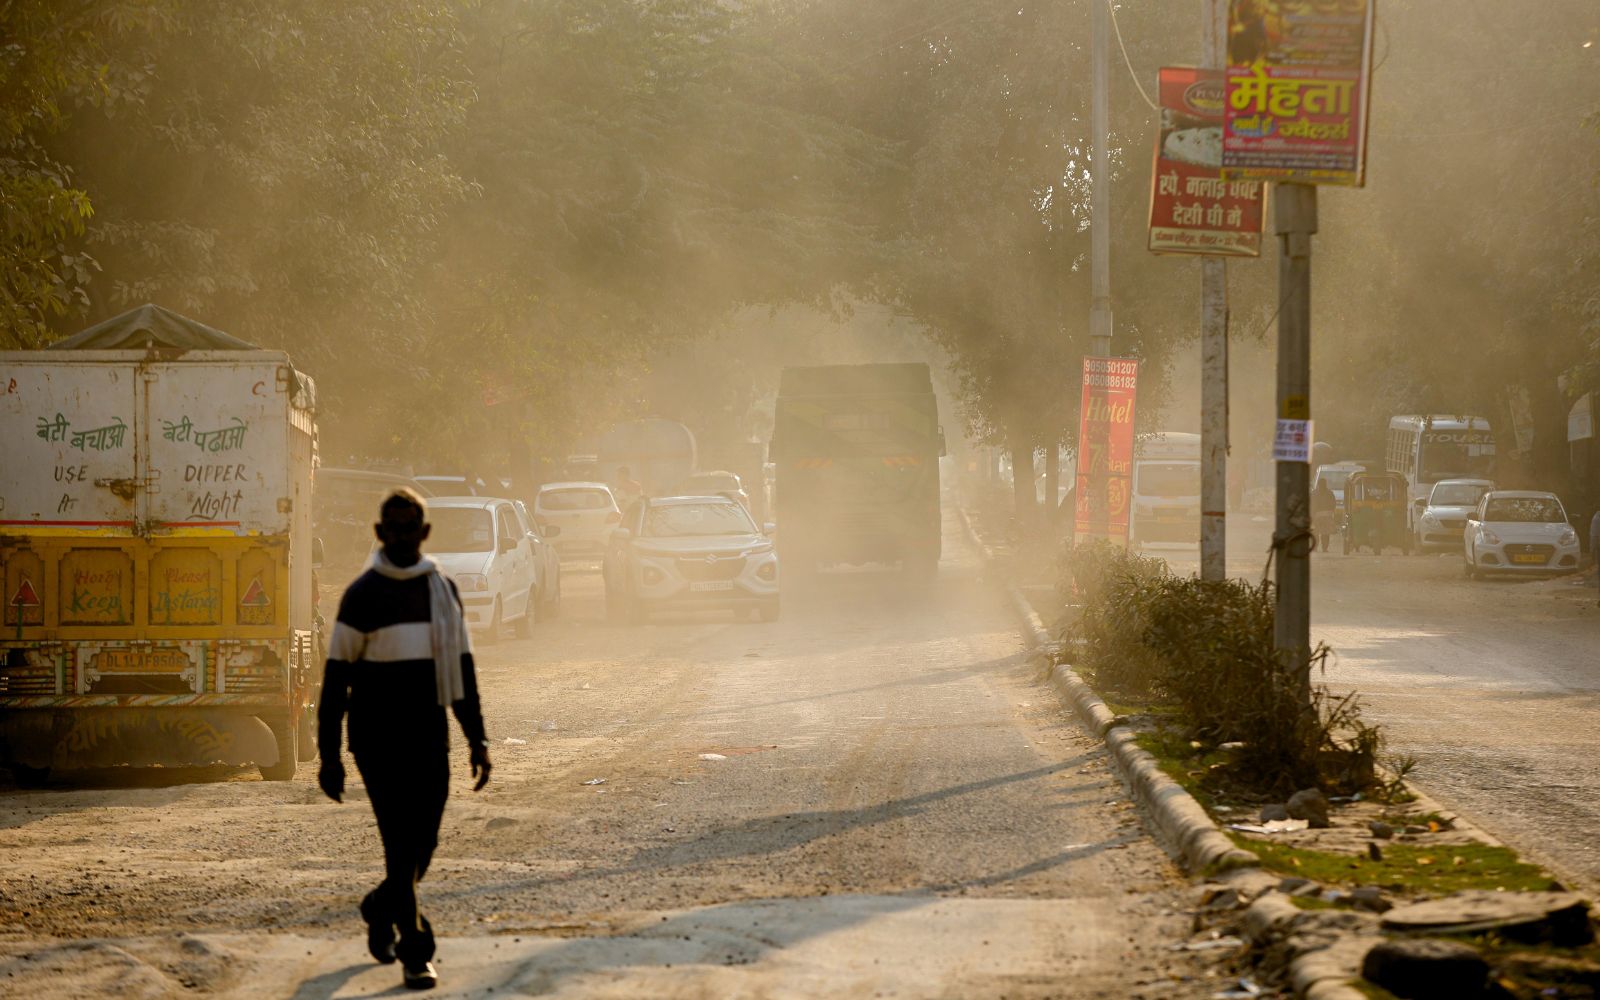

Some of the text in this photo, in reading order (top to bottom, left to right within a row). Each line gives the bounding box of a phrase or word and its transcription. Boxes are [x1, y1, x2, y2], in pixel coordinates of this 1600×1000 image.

[1229, 59, 1356, 116] मेहता
[1085, 360, 1137, 375] 9050501207
[1086, 397, 1133, 424] Hotel
[36, 413, 128, 451] बेटी बचाओ
[162, 415, 194, 442] बेटी
[54, 464, 89, 484] USE
[184, 463, 248, 483] DIPPER
[186, 489, 244, 520] Night
